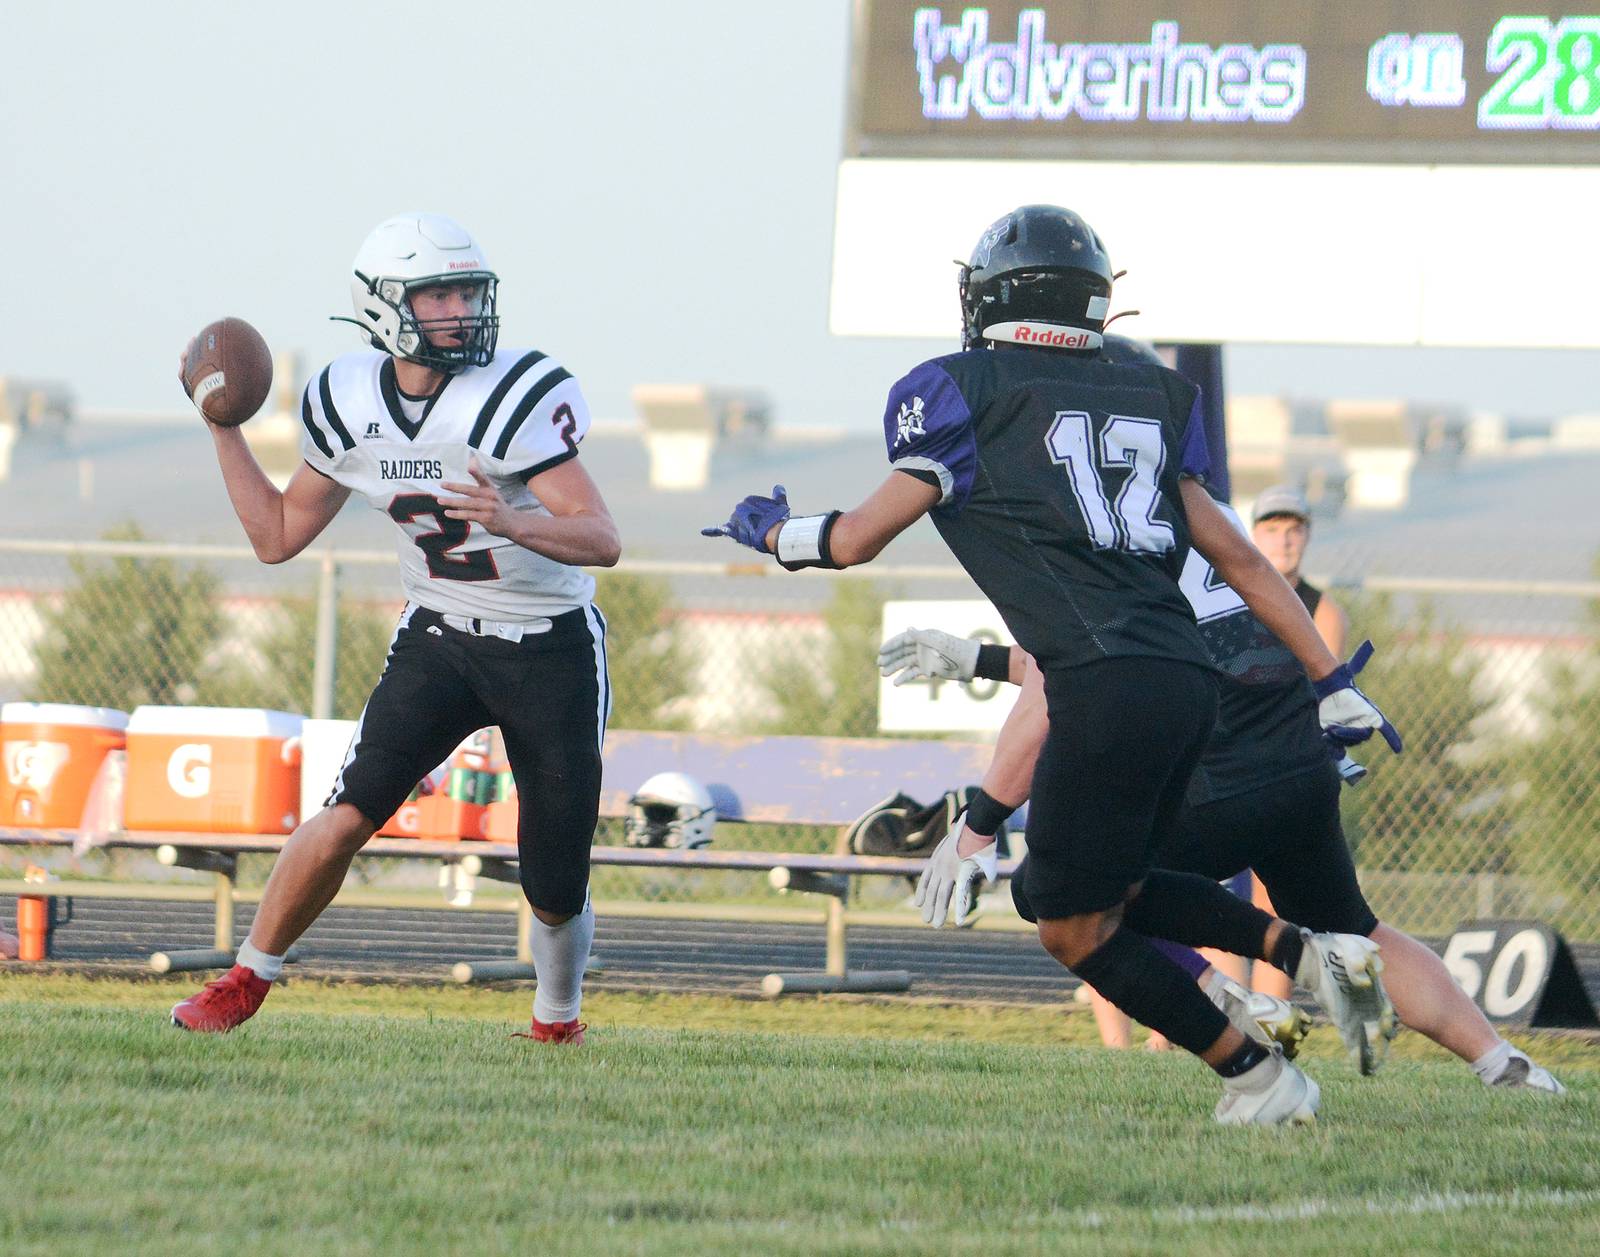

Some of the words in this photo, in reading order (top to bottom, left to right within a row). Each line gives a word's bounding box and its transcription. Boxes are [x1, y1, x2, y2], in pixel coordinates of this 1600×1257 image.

[913, 7, 1307, 121] Wolverines
[1366, 32, 1466, 107] on
[1476, 15, 1600, 130] 28
[1013, 326, 1089, 348] Riddell
[380, 460, 443, 480] RAIDERS
[1044, 410, 1176, 557] 12
[387, 492, 501, 581] 2
[167, 743, 212, 798] G
[1442, 929, 1548, 1018] 50
